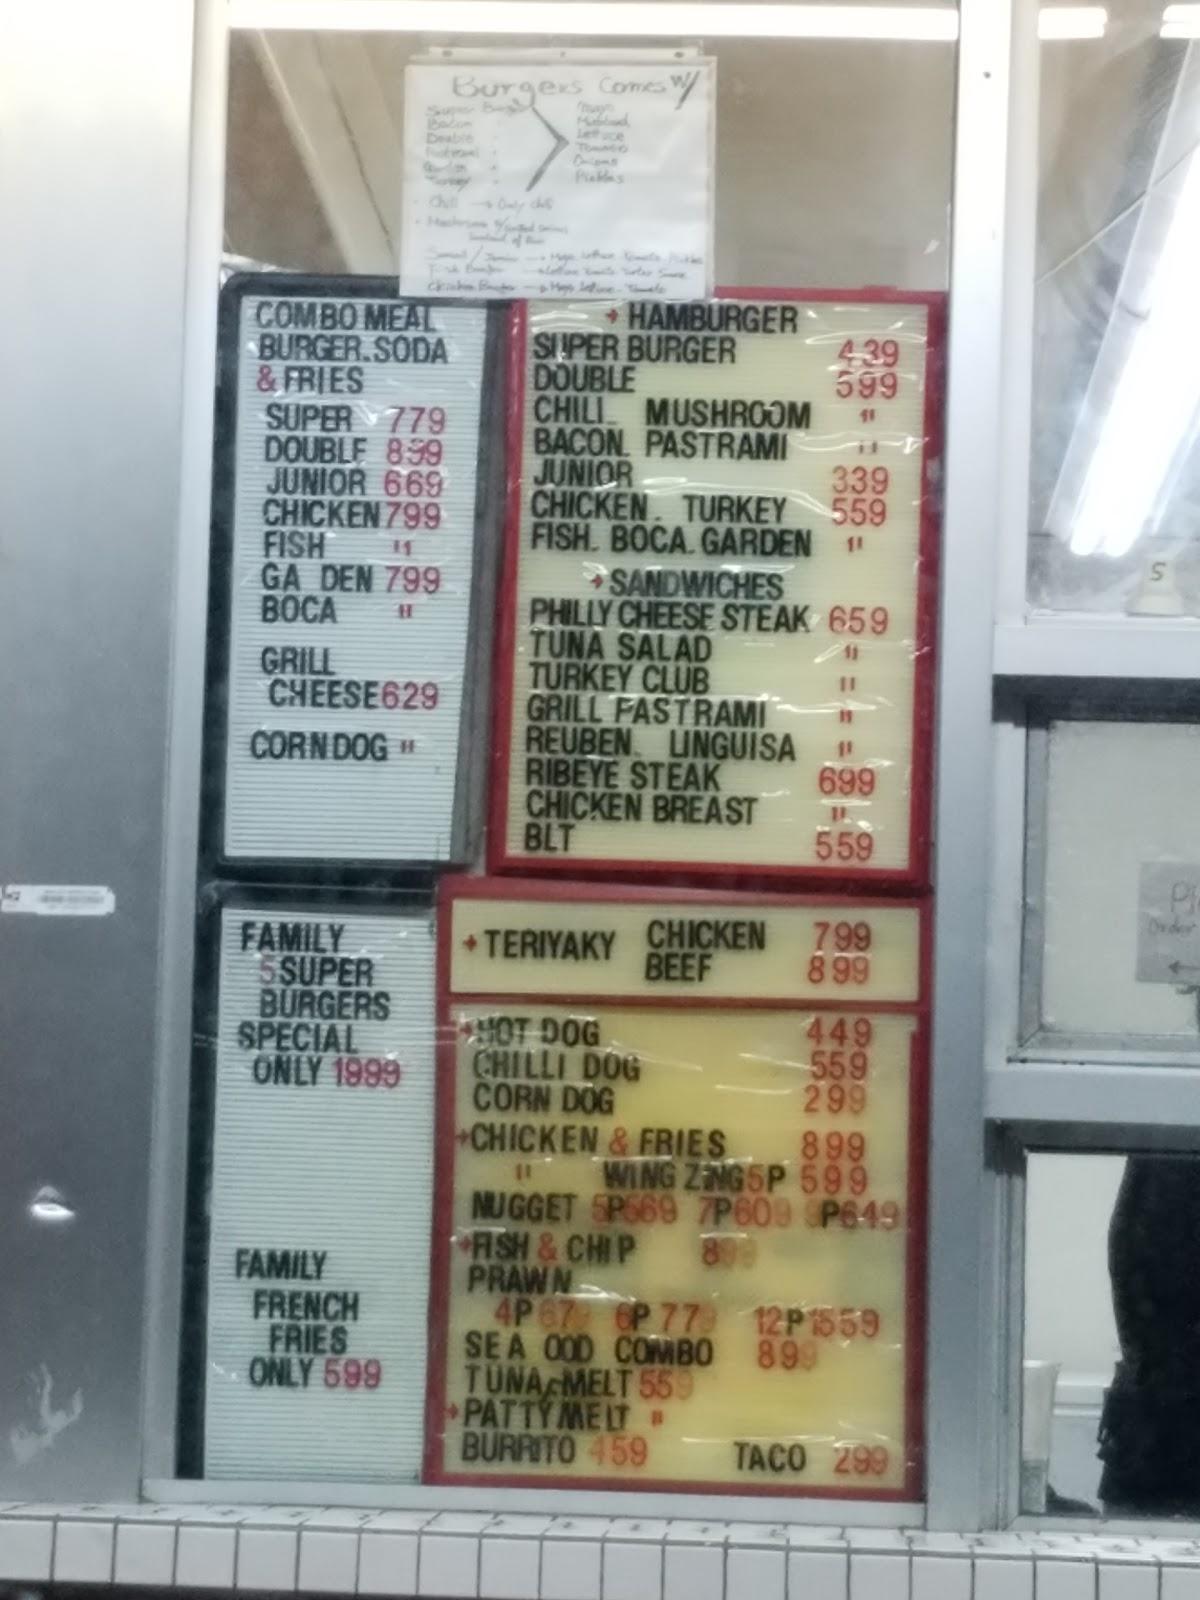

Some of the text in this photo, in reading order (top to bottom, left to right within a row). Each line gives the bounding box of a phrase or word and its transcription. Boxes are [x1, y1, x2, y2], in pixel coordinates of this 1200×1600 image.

[452, 74, 583, 108] Burgers
[599, 77, 667, 95] Comes
[256, 300, 436, 333] COMBO MEAL
[628, 303, 798, 335] HAMBURGER
[533, 331, 899, 368] SUPER BURGER 439
[256, 364, 364, 394] & FRIES
[534, 363, 897, 399] DOUBLE 599
[266, 403, 446, 434] SUPER 779
[645, 398, 811, 430] MUSHROOM
[264, 435, 367, 465] DOUBLE
[645, 431, 788, 461] PASTRAMI
[266, 466, 444, 498] JUNIOR 669
[534, 459, 889, 495] JUNIOR 339
[262, 498, 442, 530] CHICKEN 799
[683, 495, 787, 525] TURKEY
[833, 497, 887, 526] 559
[264, 530, 325, 559] FISH
[702, 527, 812, 557] GARDEN
[385, 565, 441, 594] 799
[609, 569, 785, 601] SANDWICHES
[261, 595, 338, 624] BOCA
[530, 598, 890, 636] PHILLY CHEESE STEAK 659
[261, 646, 336, 676] GRILL
[530, 630, 712, 663] TUNA SALAD
[269, 678, 439, 710] CHEESE 629
[530, 662, 710, 695] TURKEY CLUB
[527, 695, 766, 729] GRILL PASTRAMI
[251, 730, 389, 761] CORN DOG
[669, 730, 796, 761] LINGUISA
[527, 759, 875, 796] RIBEYE STEAK 699
[526, 790, 758, 825] CHICKEN BREAST
[525, 823, 873, 860] BLT 559
[241, 921, 345, 953] FAMILY
[484, 920, 872, 962] TERIYAKY CHICKEN 799
[645, 953, 870, 984] BEEF 899
[259, 988, 391, 1021] BURGERS
[237, 1021, 359, 1054] SPECIAL
[477, 1016, 872, 1047] HOT DOG 449
[253, 1055, 402, 1088] ONLY 1999
[473, 1048, 868, 1081] CHILLI DOG 559
[473, 1082, 866, 1115] CORN DOG 299
[471, 1123, 865, 1162] CHICKEN & FRIES 899
[604, 1160, 675, 1191] WING
[801, 1164, 868, 1195] 599
[472, 1192, 577, 1223] NUGGET
[235, 1248, 327, 1280] FAMILY
[472, 1232, 528, 1262] FISH
[538, 1233, 558, 1263] &
[567, 1234, 635, 1265] CHIP
[468, 1265, 572, 1294] PRAWN
[254, 1288, 360, 1322] FRENCH
[270, 1324, 349, 1355] FRIES
[614, 1336, 713, 1366] COMBO
[250, 1356, 382, 1389] ONLY 599
[562, 1369, 633, 1398] MELT
[464, 1399, 631, 1431] PATTY MELT
[462, 1431, 576, 1464] BURRITO
[733, 1441, 806, 1472] TACO
[834, 1445, 889, 1476] 299
